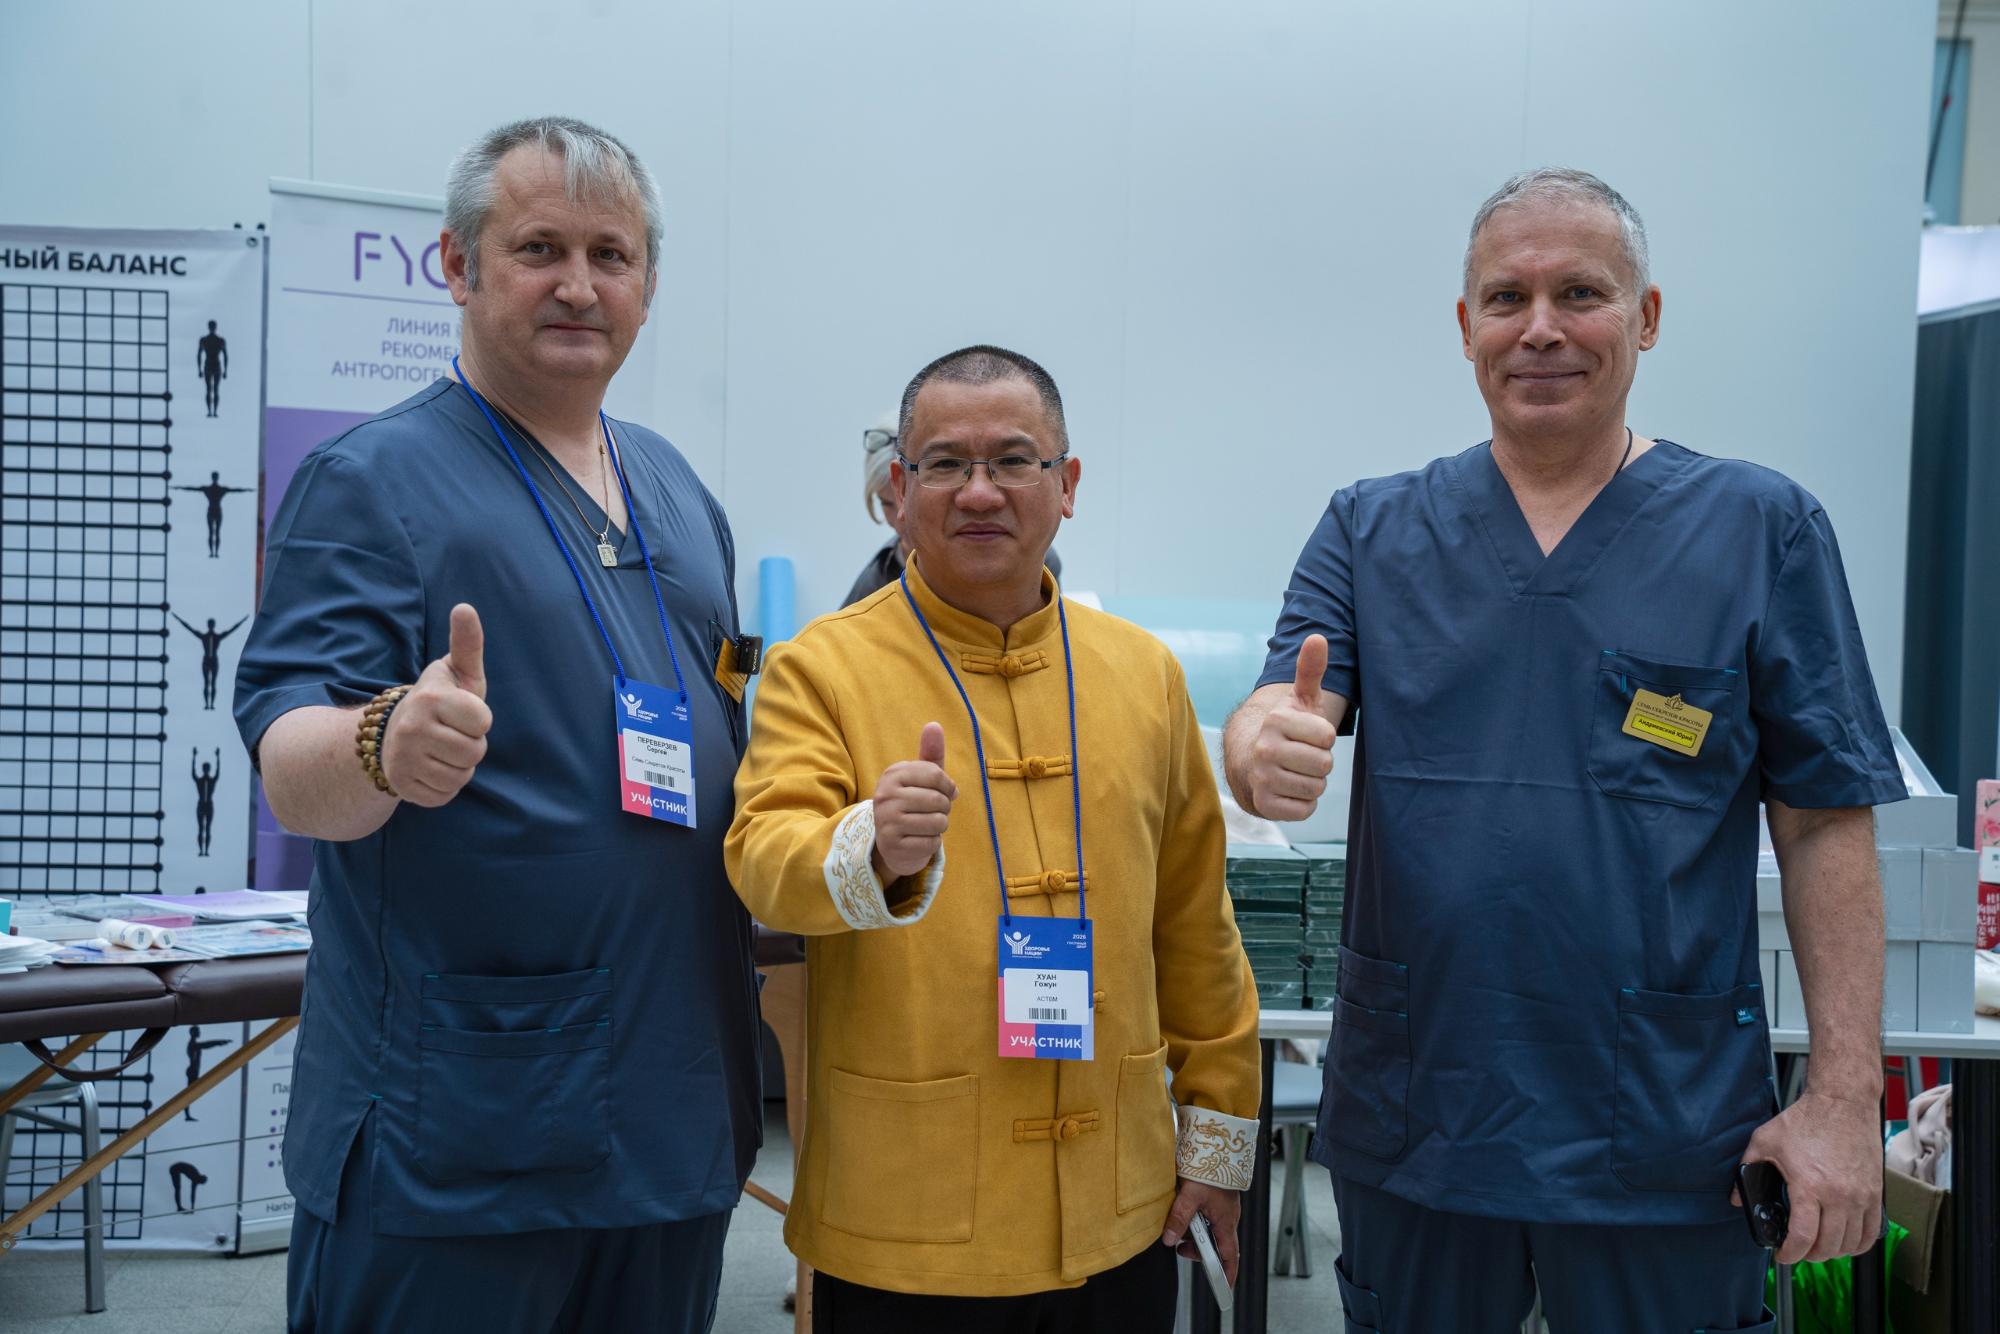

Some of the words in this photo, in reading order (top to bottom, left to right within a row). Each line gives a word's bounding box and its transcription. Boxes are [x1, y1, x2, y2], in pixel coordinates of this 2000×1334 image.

[68, 251, 188, 276] БАЛАНС
[387, 317, 450, 338] ЛИНИЯ
[381, 341, 460, 361] РЕКОМБ
[637, 736, 678, 752] ПЕРЕВЕРЗЕВ
[631, 791, 688, 816] УЧАСТНИК
[1034, 981, 1057, 989] Гожун
[1036, 973, 1057, 981] ХУАН
[1010, 1035, 1082, 1049] УЧАСТНИК
